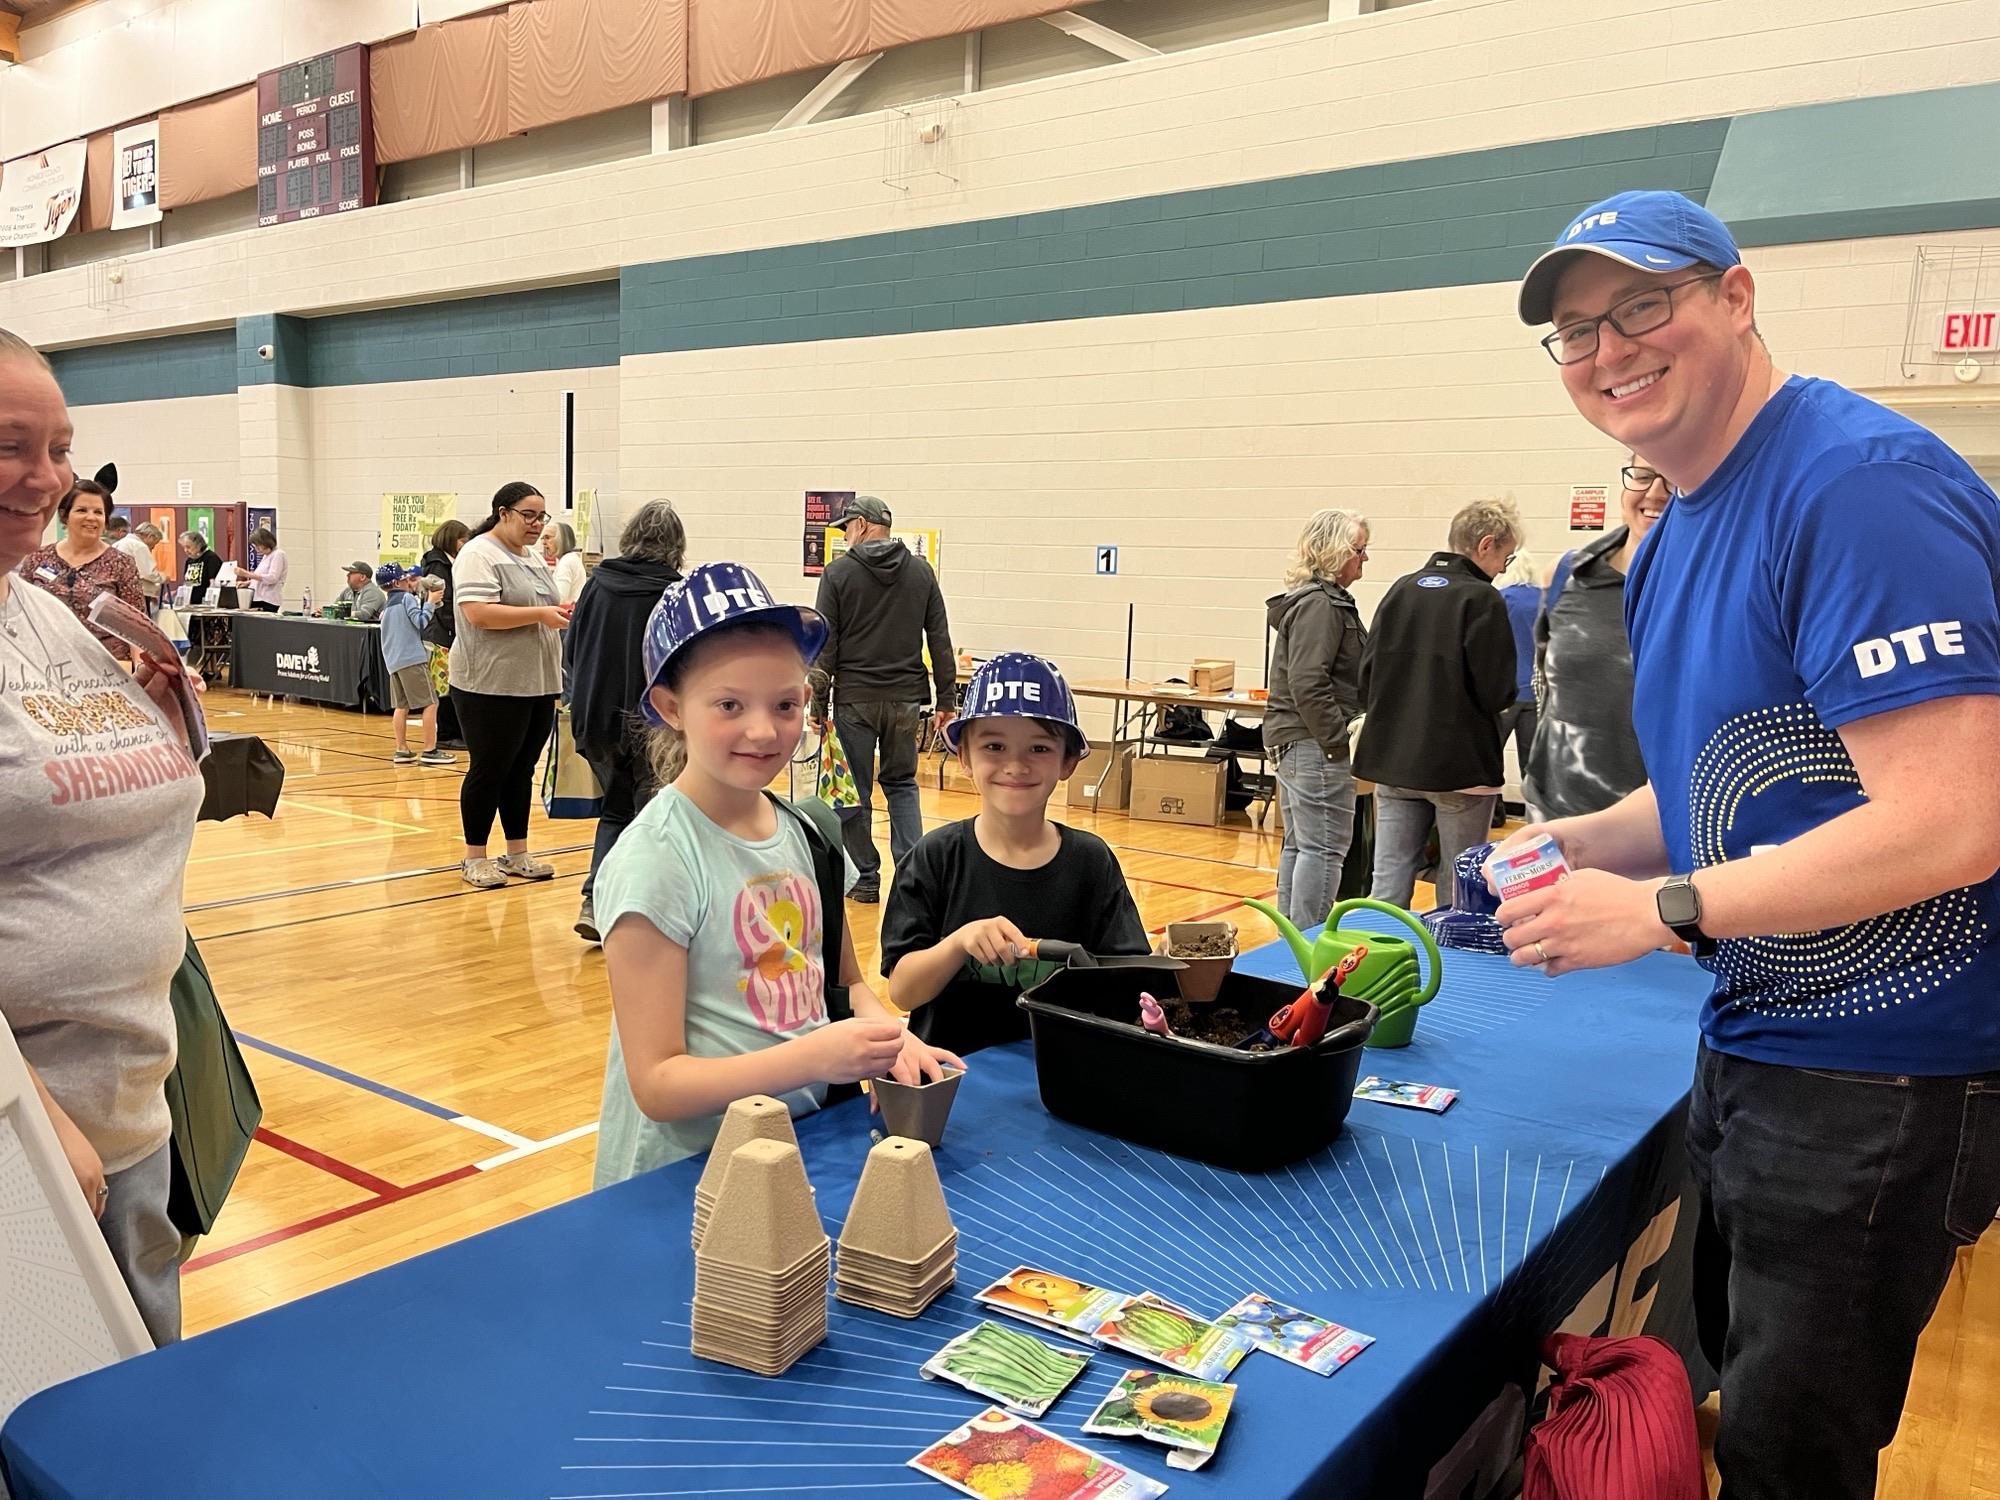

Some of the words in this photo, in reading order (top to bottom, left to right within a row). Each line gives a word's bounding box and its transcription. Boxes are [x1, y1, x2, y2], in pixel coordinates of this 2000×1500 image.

[329, 90, 355, 107] GUEST
[296, 104, 316, 116] PERIOD
[262, 111, 282, 126] HOME
[298, 128, 314, 140] POSS
[297, 140, 316, 152] BONUS
[340, 145, 360, 158] FOULS
[288, 157, 309, 170] PLAYER
[316, 152, 331, 163] FOUL
[259, 164, 276, 176] FOULS
[122, 173, 154, 198] TIGER?
[300, 207, 320, 218] MATCH
[339, 200, 358, 212] SCORE
[260, 215, 278, 226] SCORE
[1566, 211, 1618, 241] DTE
[1945, 314, 1996, 348] EXIT
[394, 495, 410, 504] HAVE
[411, 495, 424, 504] YOU
[392, 505, 406, 513] HAD
[408, 505, 425, 513] YOUR
[392, 514, 408, 522] TREE
[392, 523, 416, 532] TODAY?
[392, 534, 399, 548] 5
[1100, 549, 1112, 572] 1
[703, 588, 770, 616] DTE
[1853, 620, 1965, 679] DTE
[276, 652, 308, 671] DAVEY
[986, 681, 1041, 702] DTE
[55, 731, 91, 756] with
[110, 720, 152, 750] chance
[156, 716, 168, 739] of
[1502, 881, 1530, 894] COSMOS
[1095, 1470, 1122, 1490] ZINNIA
